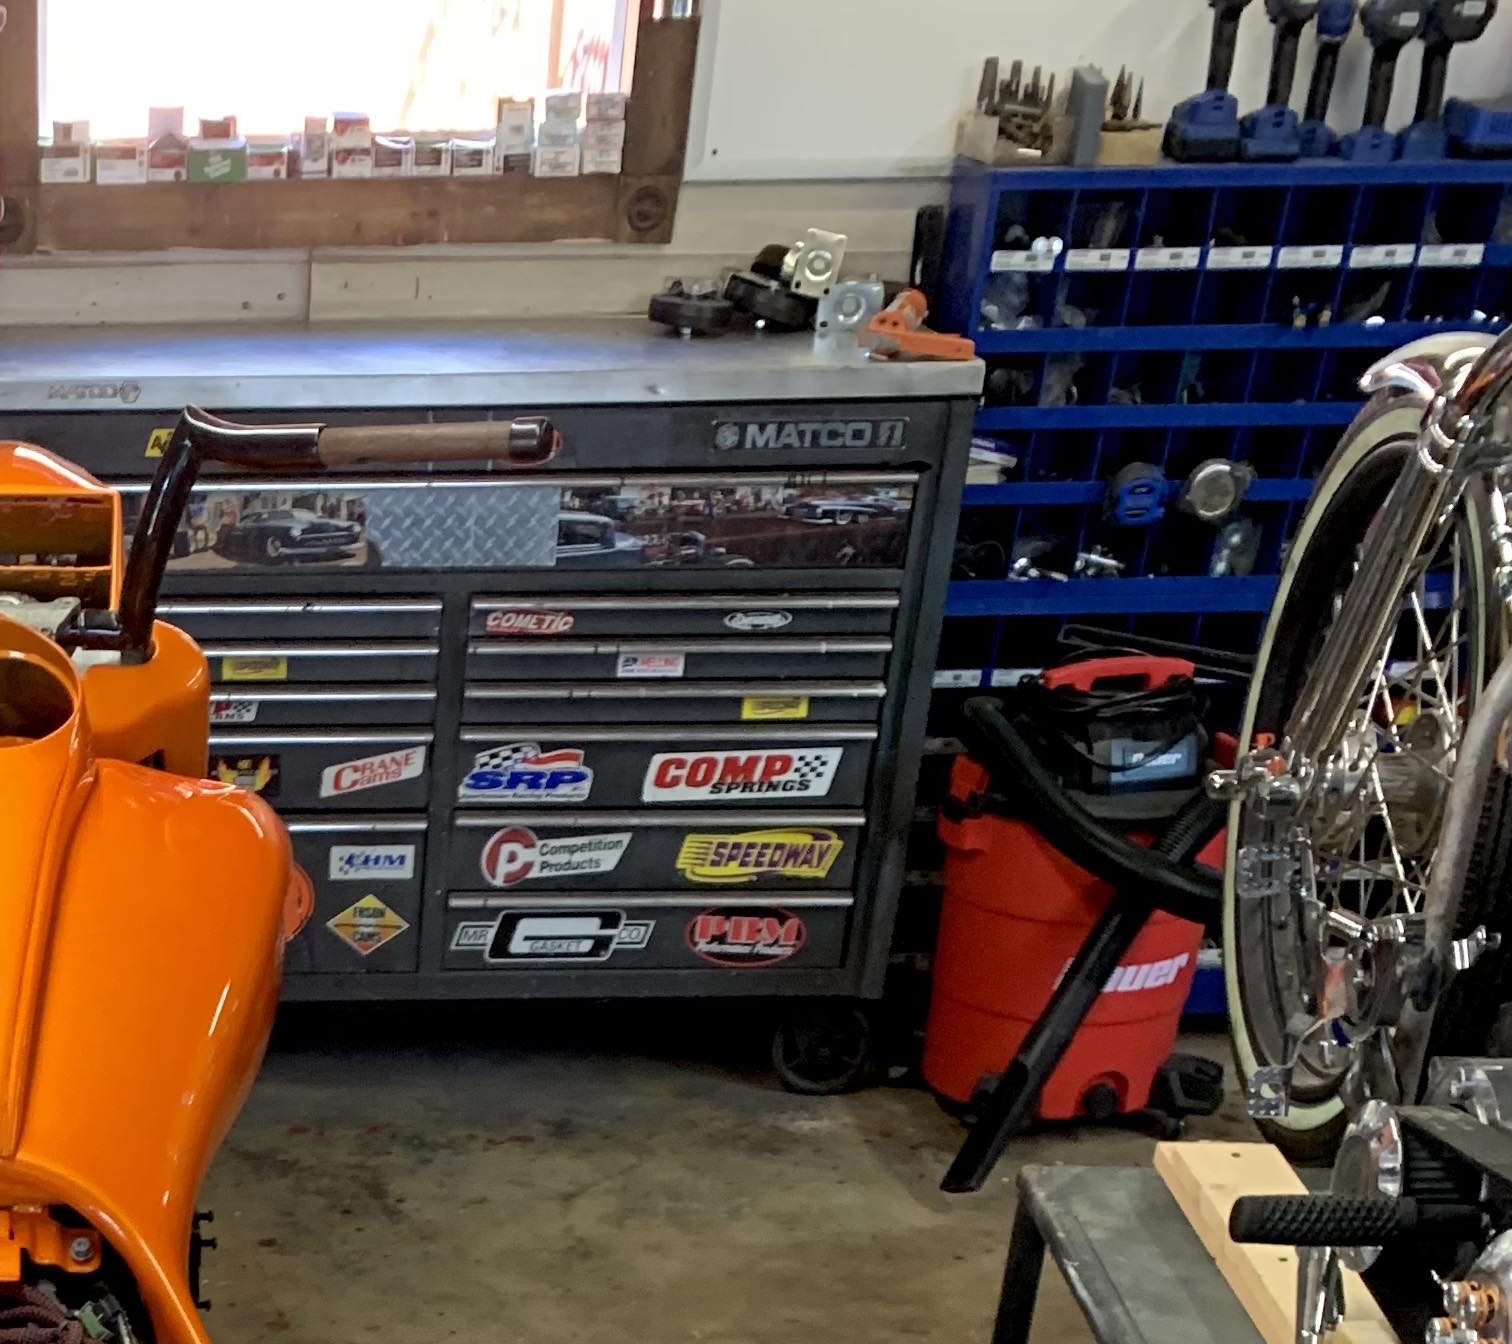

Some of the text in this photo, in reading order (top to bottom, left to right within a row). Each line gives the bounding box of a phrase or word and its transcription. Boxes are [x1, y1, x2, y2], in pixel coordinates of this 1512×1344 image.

[745, 421, 872, 448] MATCO
[487, 611, 575, 632] COMETIC
[465, 770, 588, 790] SRP
[653, 754, 794, 789] COMP
[709, 779, 811, 795] SPRINGS
[539, 839, 624, 856] Competition
[707, 840, 833, 869] SPEEDWAY
[539, 858, 601, 873] Products
